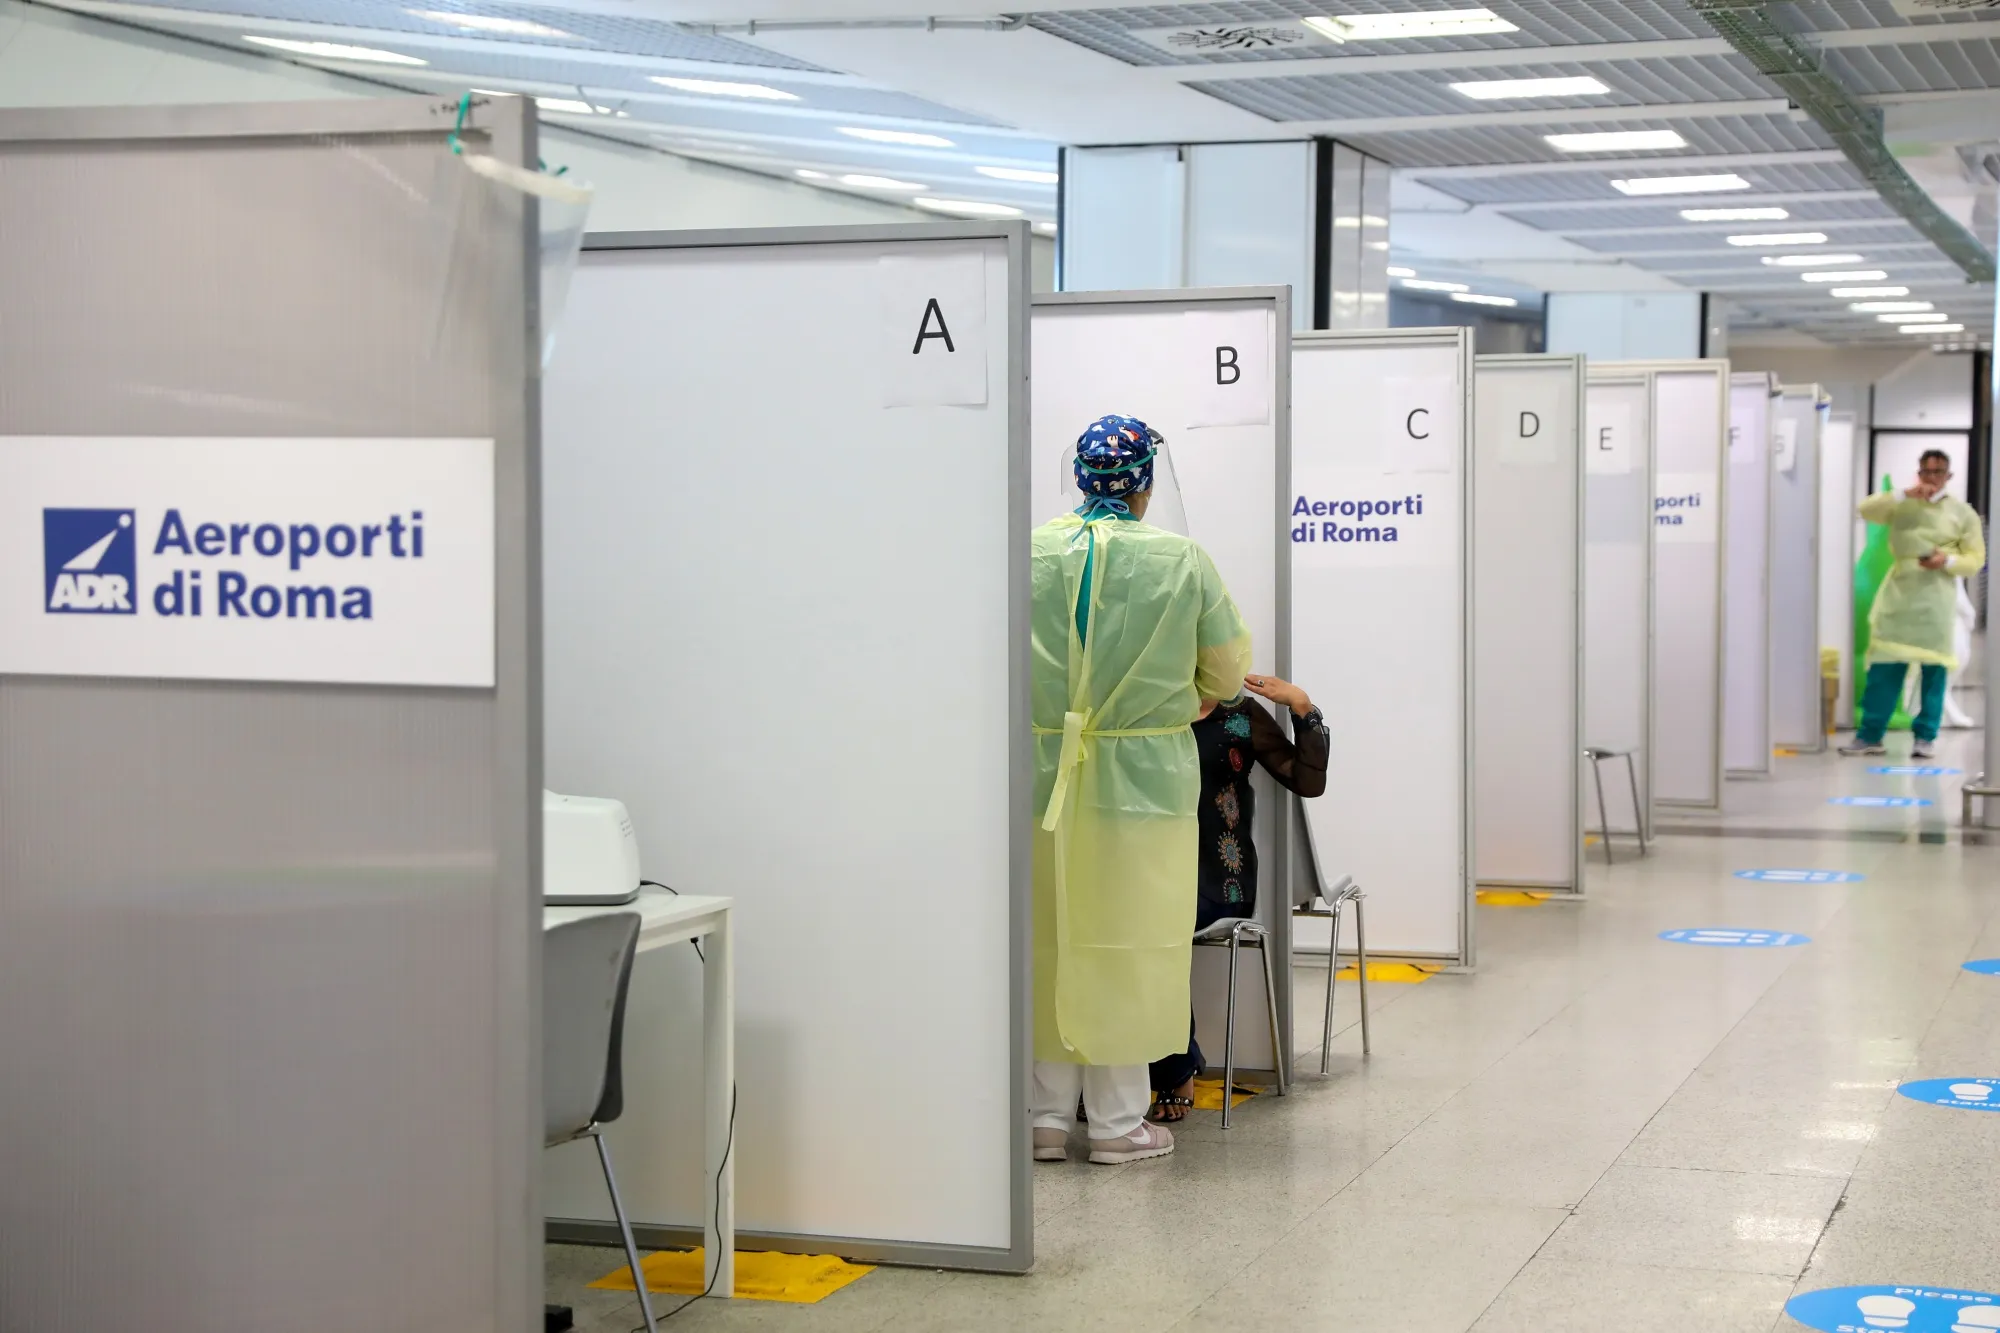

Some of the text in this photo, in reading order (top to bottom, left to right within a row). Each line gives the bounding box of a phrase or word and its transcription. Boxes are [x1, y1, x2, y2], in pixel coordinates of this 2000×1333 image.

[912, 297, 956, 355] A
[1215, 345, 1241, 385] B
[1406, 408, 1430, 440] C
[1519, 411, 1540, 438] D
[1599, 427, 1613, 451] E
[1292, 494, 1423, 522] Aeroporti
[153, 508, 424, 571] Aeroporti
[1291, 521, 1399, 543] di Roma
[49, 573, 132, 611] ADR
[153, 570, 373, 620] di Roma
[1894, 1287, 1992, 1303] Please
